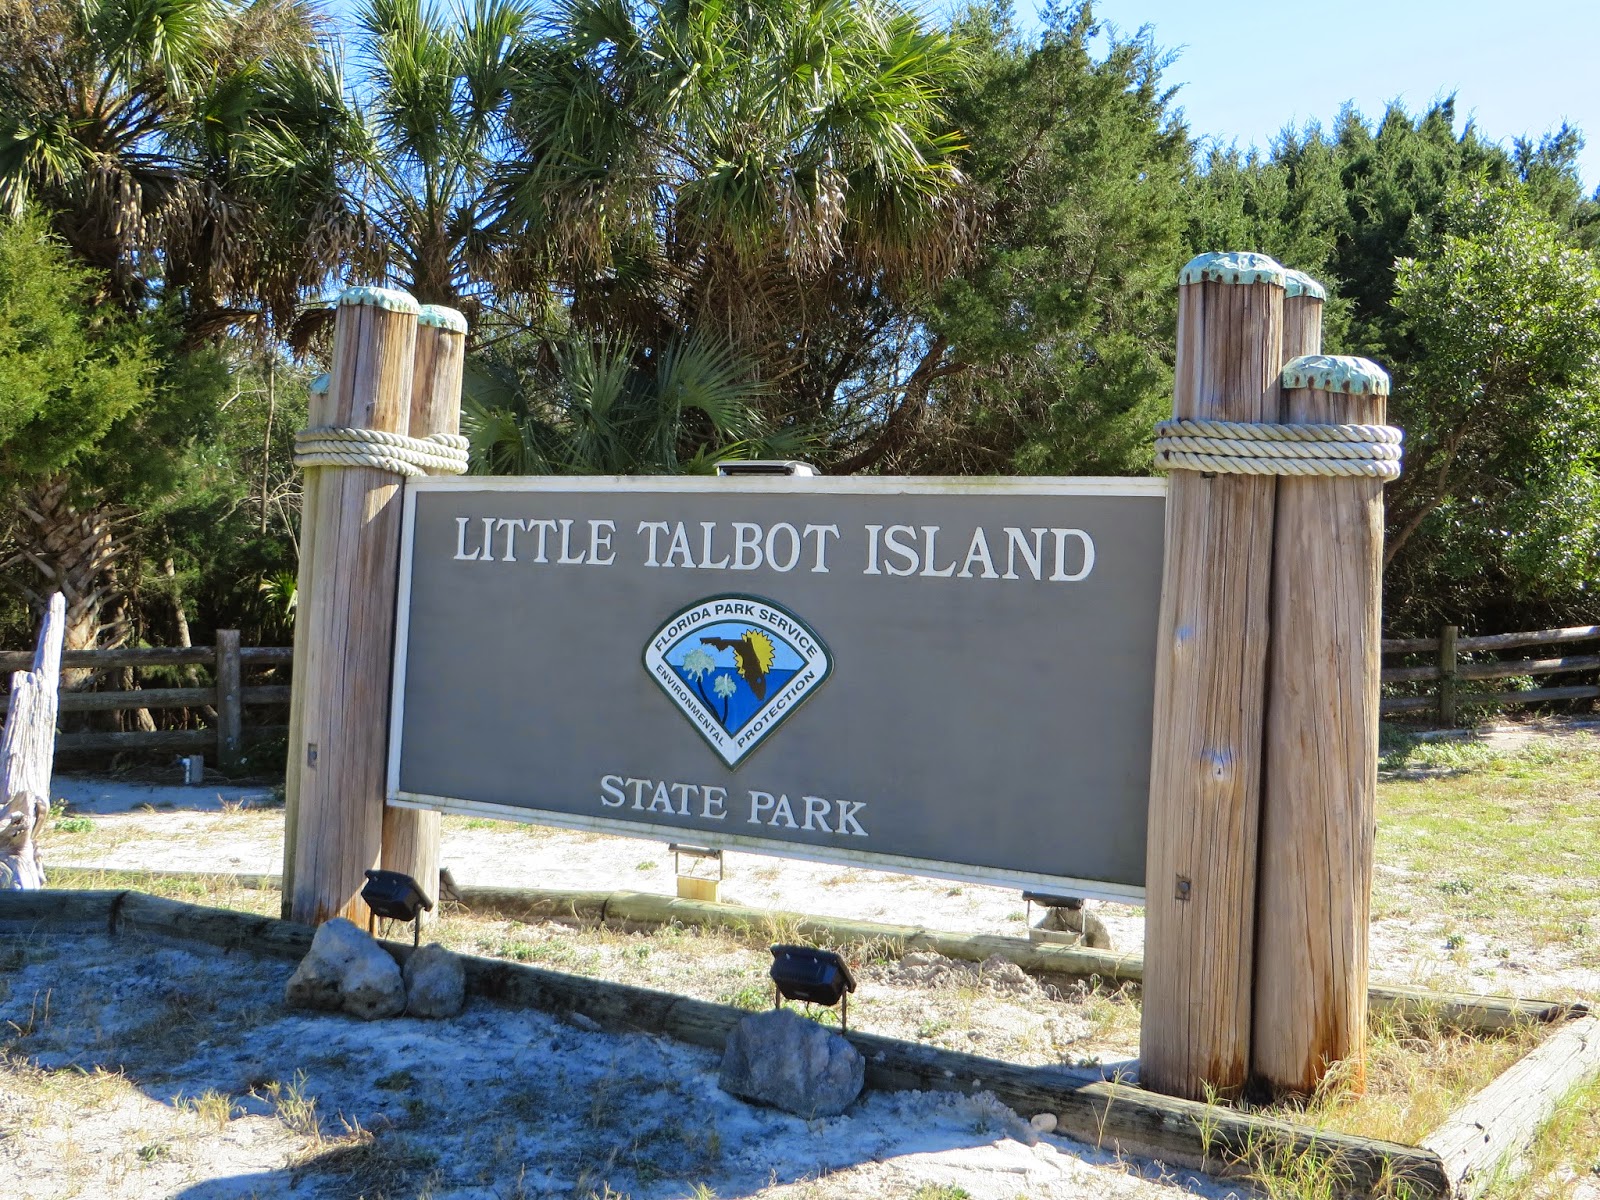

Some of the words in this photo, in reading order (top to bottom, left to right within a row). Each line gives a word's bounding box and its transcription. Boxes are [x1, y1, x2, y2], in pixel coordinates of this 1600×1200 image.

[453, 517, 616, 566] LITTLE
[637, 520, 840, 574] TALBOT
[864, 524, 1096, 583] ISLAND
[654, 608, 711, 652] FLORIDA
[714, 603, 756, 616] PARK
[759, 608, 818, 659] SERVICE
[656, 664, 724, 747] ENVIRONMENTAL
[737, 670, 815, 748] PROTECTION
[599, 774, 727, 821] STATE
[748, 790, 869, 838] PARK
